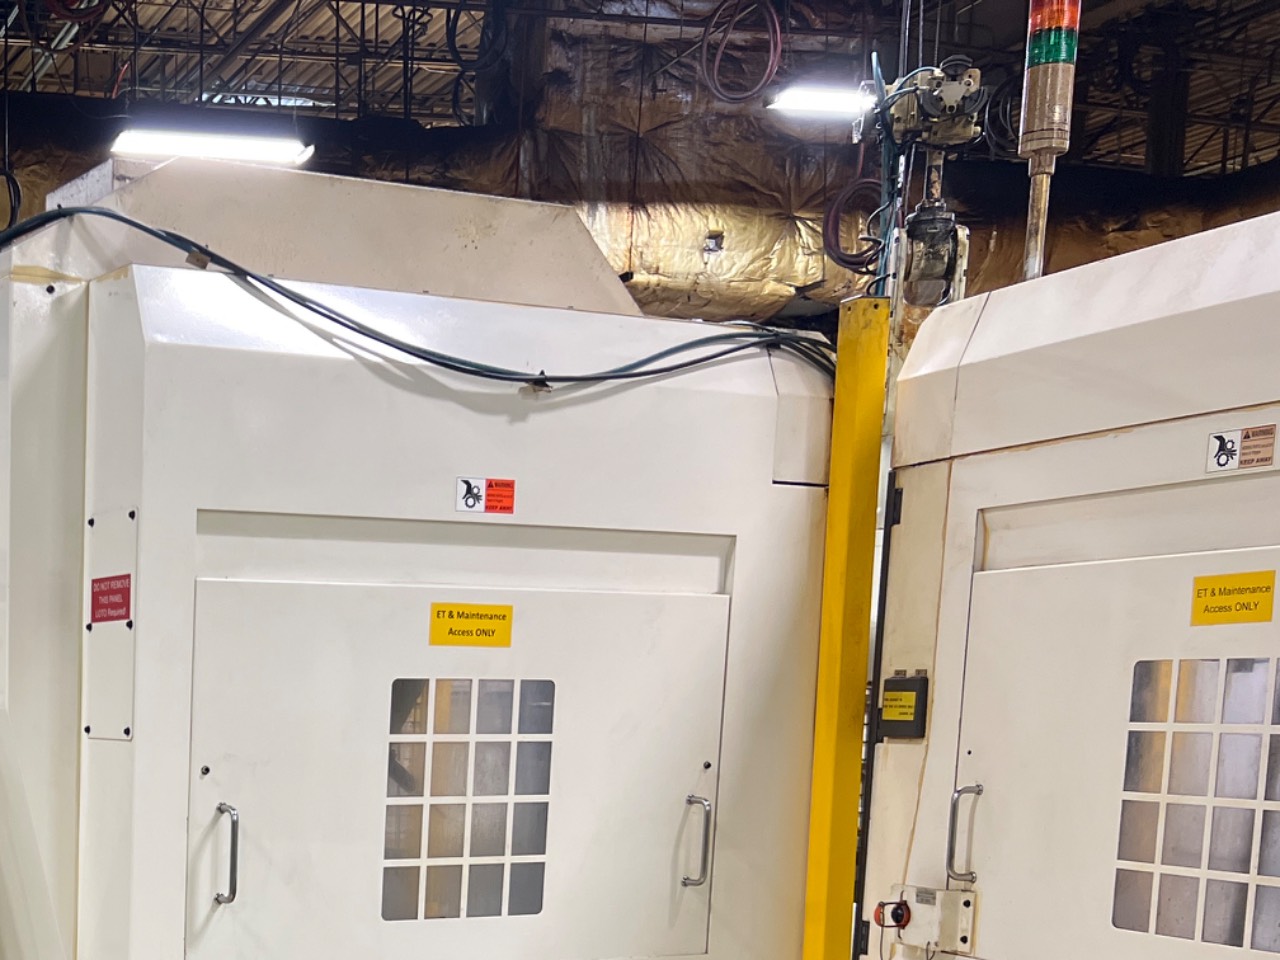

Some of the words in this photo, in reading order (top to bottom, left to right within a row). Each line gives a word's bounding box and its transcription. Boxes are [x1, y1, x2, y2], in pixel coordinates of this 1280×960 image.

[101, 581, 110, 591] NOT
[111, 579, 130, 589] REMOVE
[1196, 588, 1208, 598] ET
[1210, 587, 1216, 597] &
[1219, 585, 1271, 597] Maintenance
[1203, 604, 1233, 613] Access
[1235, 601, 1260, 612] ONLY
[436, 610, 446, 619] ET
[448, 610, 455, 619] &
[456, 611, 507, 621] Maintenance
[447, 627, 474, 637] Access
[475, 627, 496, 637] ONLY
